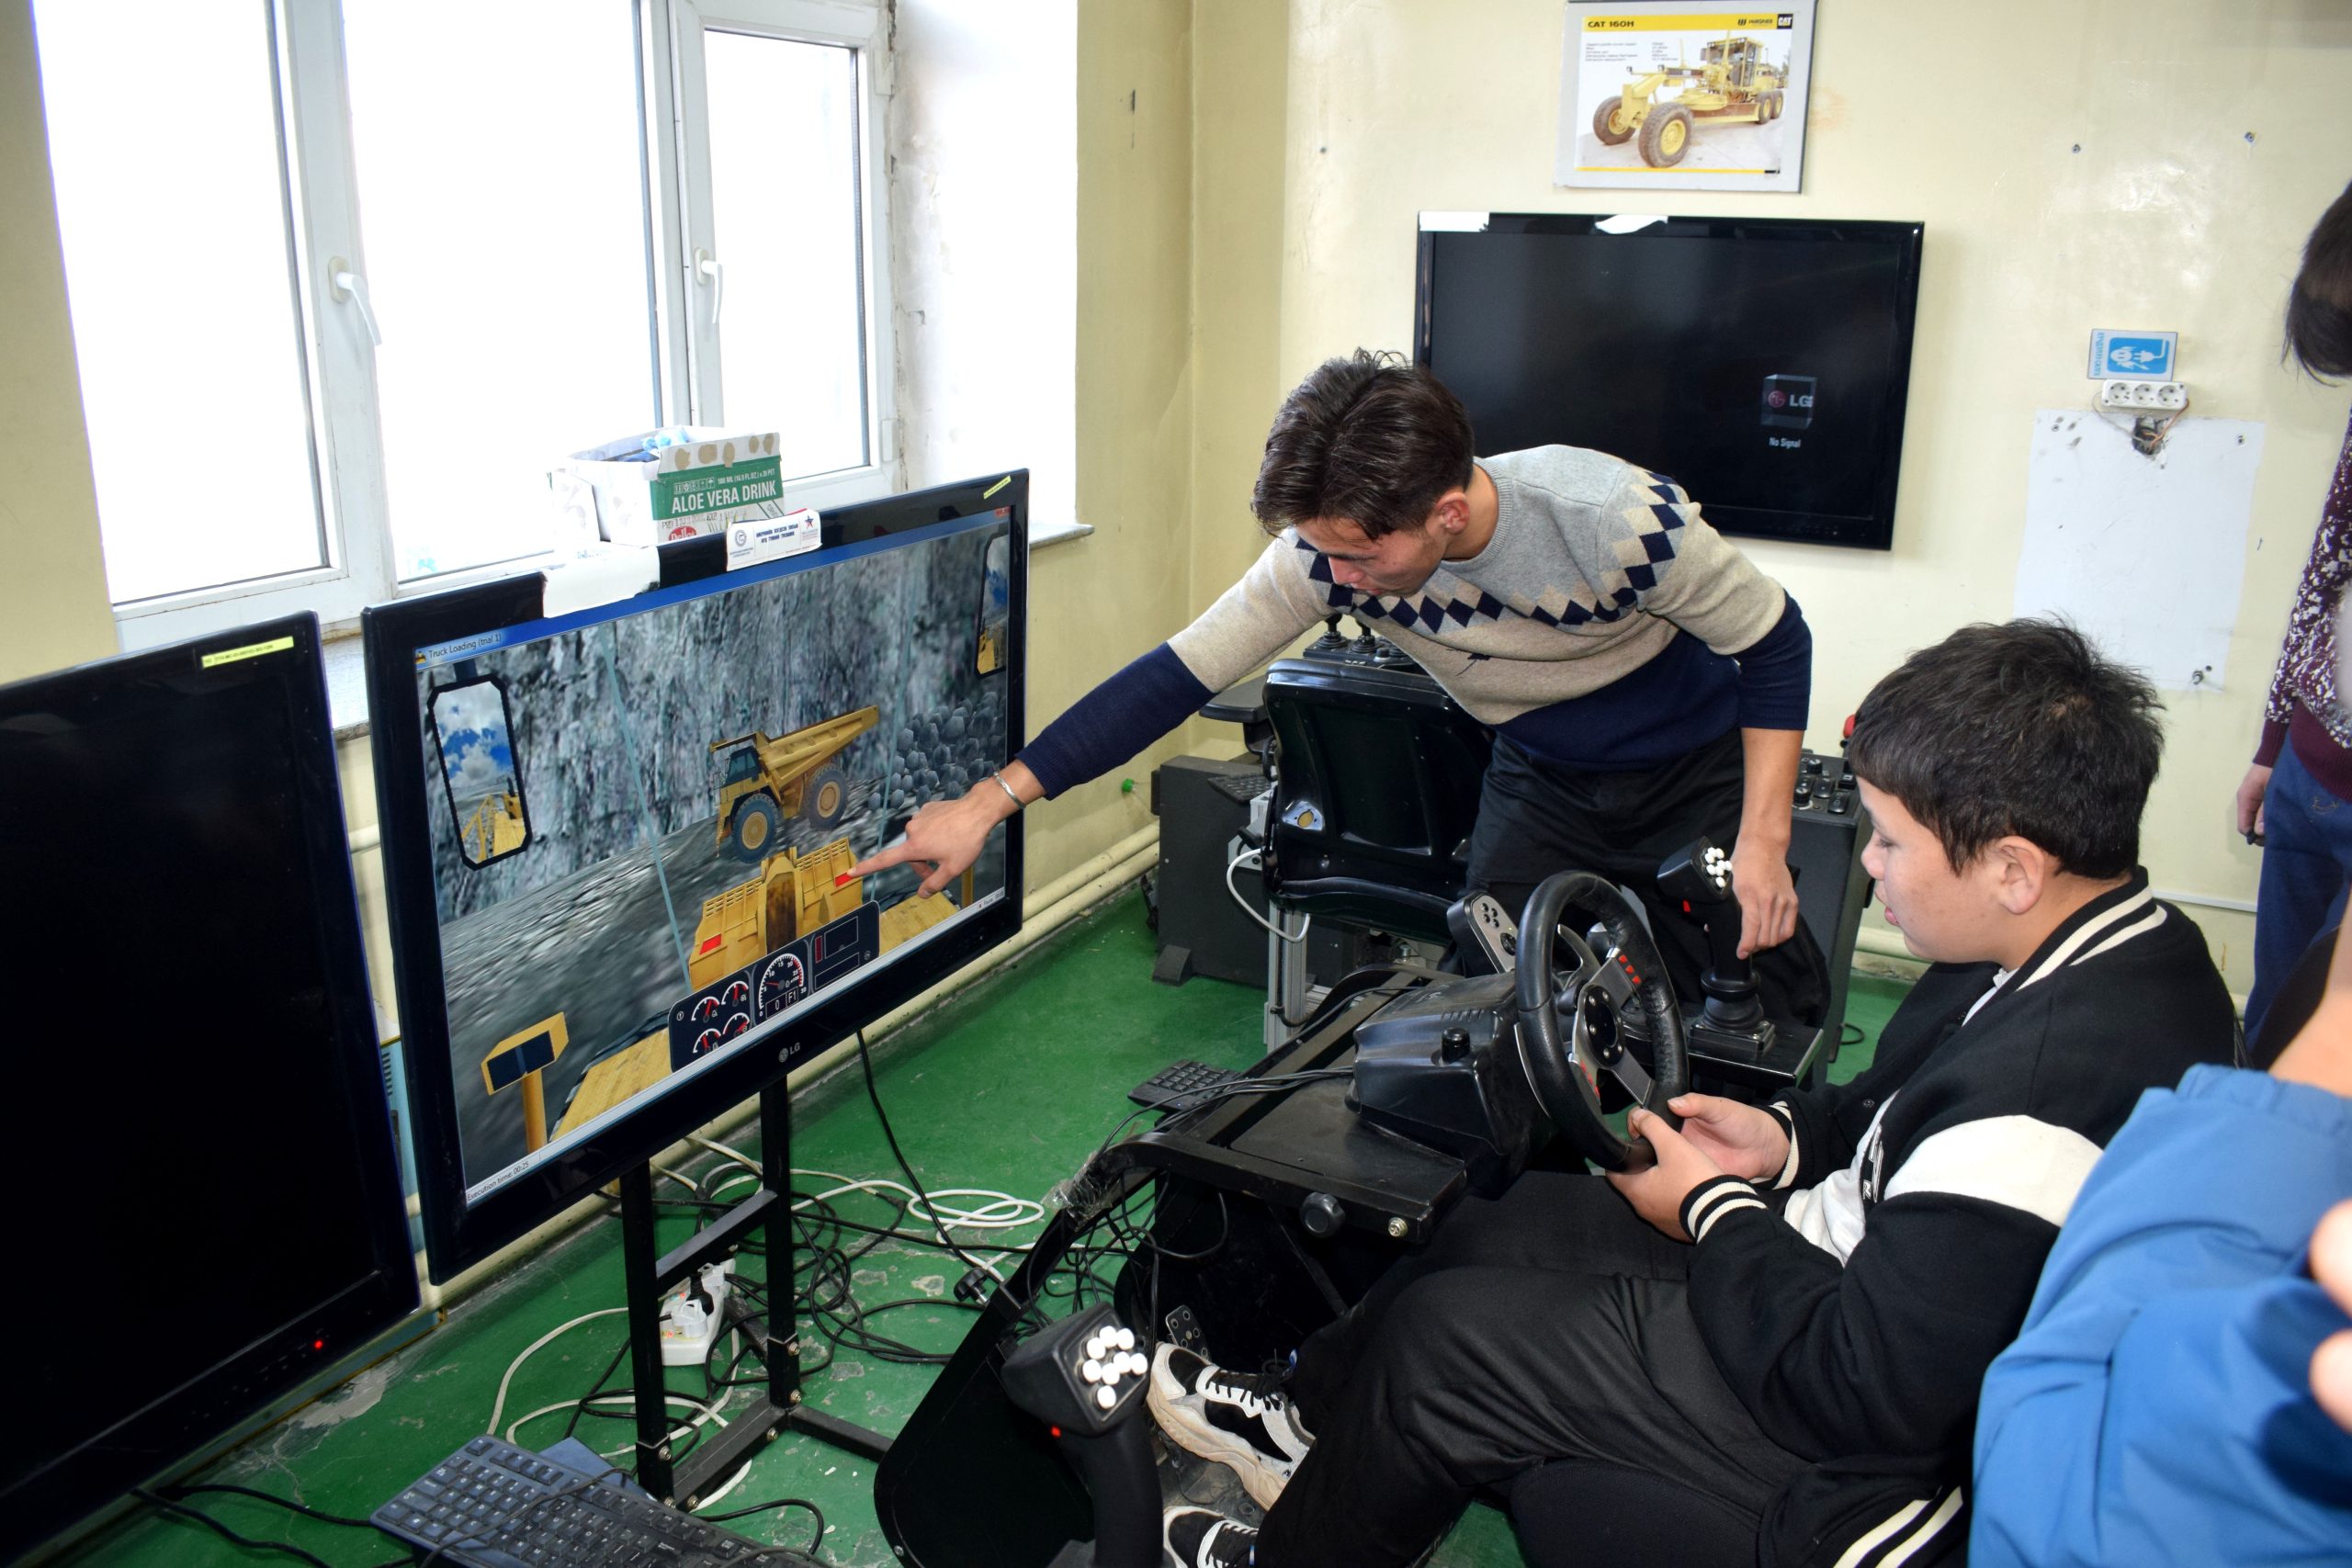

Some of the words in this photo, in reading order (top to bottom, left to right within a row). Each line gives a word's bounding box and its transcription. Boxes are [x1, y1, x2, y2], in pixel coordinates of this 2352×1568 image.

[1778, 17, 1792, 26] CAT
[1769, 437, 1780, 446] No
[1781, 437, 1801, 449] Signal
[672, 492, 705, 514] ALOE
[707, 487, 740, 508] VERA
[742, 479, 776, 502] DRINK
[428, 648, 447, 659] Truck
[449, 641, 477, 654] Loading
[478, 636, 493, 647] (trial
[494, 633, 502, 643] 1)
[788, 990, 796, 1003] F1
[790, 1042, 800, 1055] LG
[467, 1181, 496, 1201] Execution
[497, 1172, 513, 1183] time:
[514, 1161, 529, 1174] 00:25
